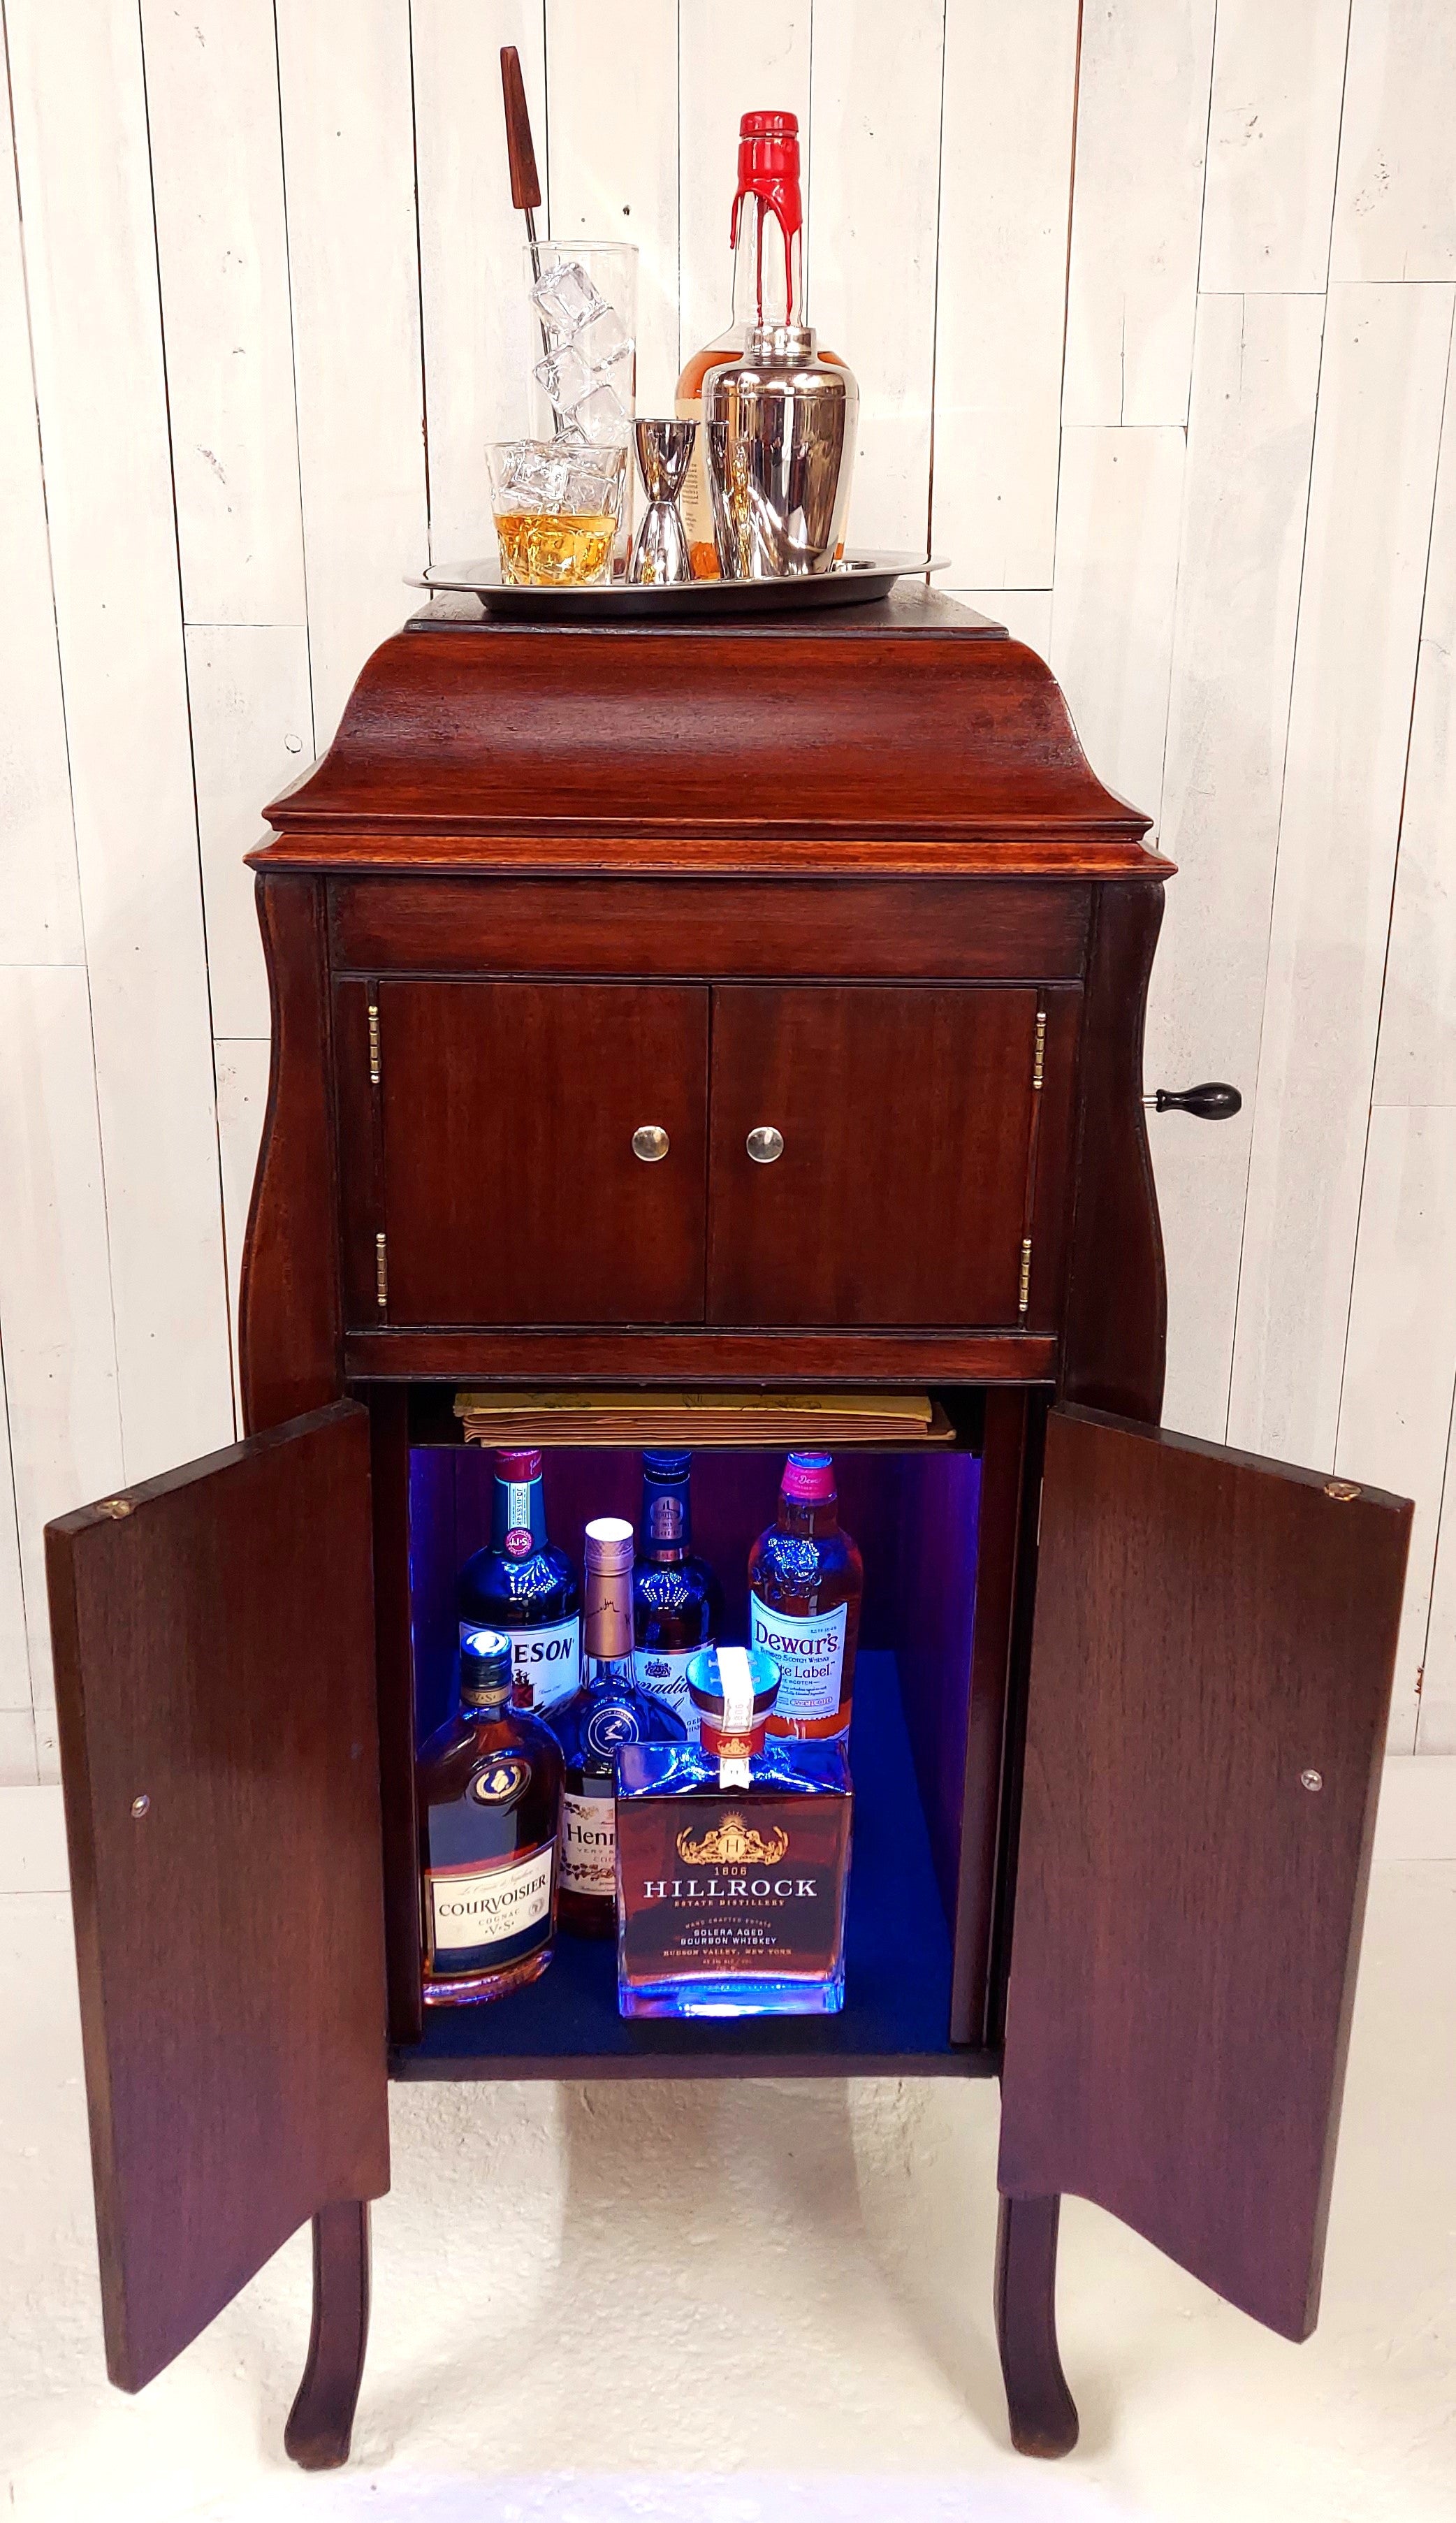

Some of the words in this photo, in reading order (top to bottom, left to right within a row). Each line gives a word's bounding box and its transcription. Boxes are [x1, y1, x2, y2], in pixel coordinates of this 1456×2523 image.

[755, 1619, 838, 1655] Dewar's
[514, 1638, 573, 1663] ESON
[439, 1874, 546, 1917] COURVOISIER
[643, 1879, 817, 1898] HILLROCK
[479, 1908, 520, 1926] COGNAC
[680, 1937, 728, 1946] BOURBON
[663, 1948, 699, 1957] HUDSON
